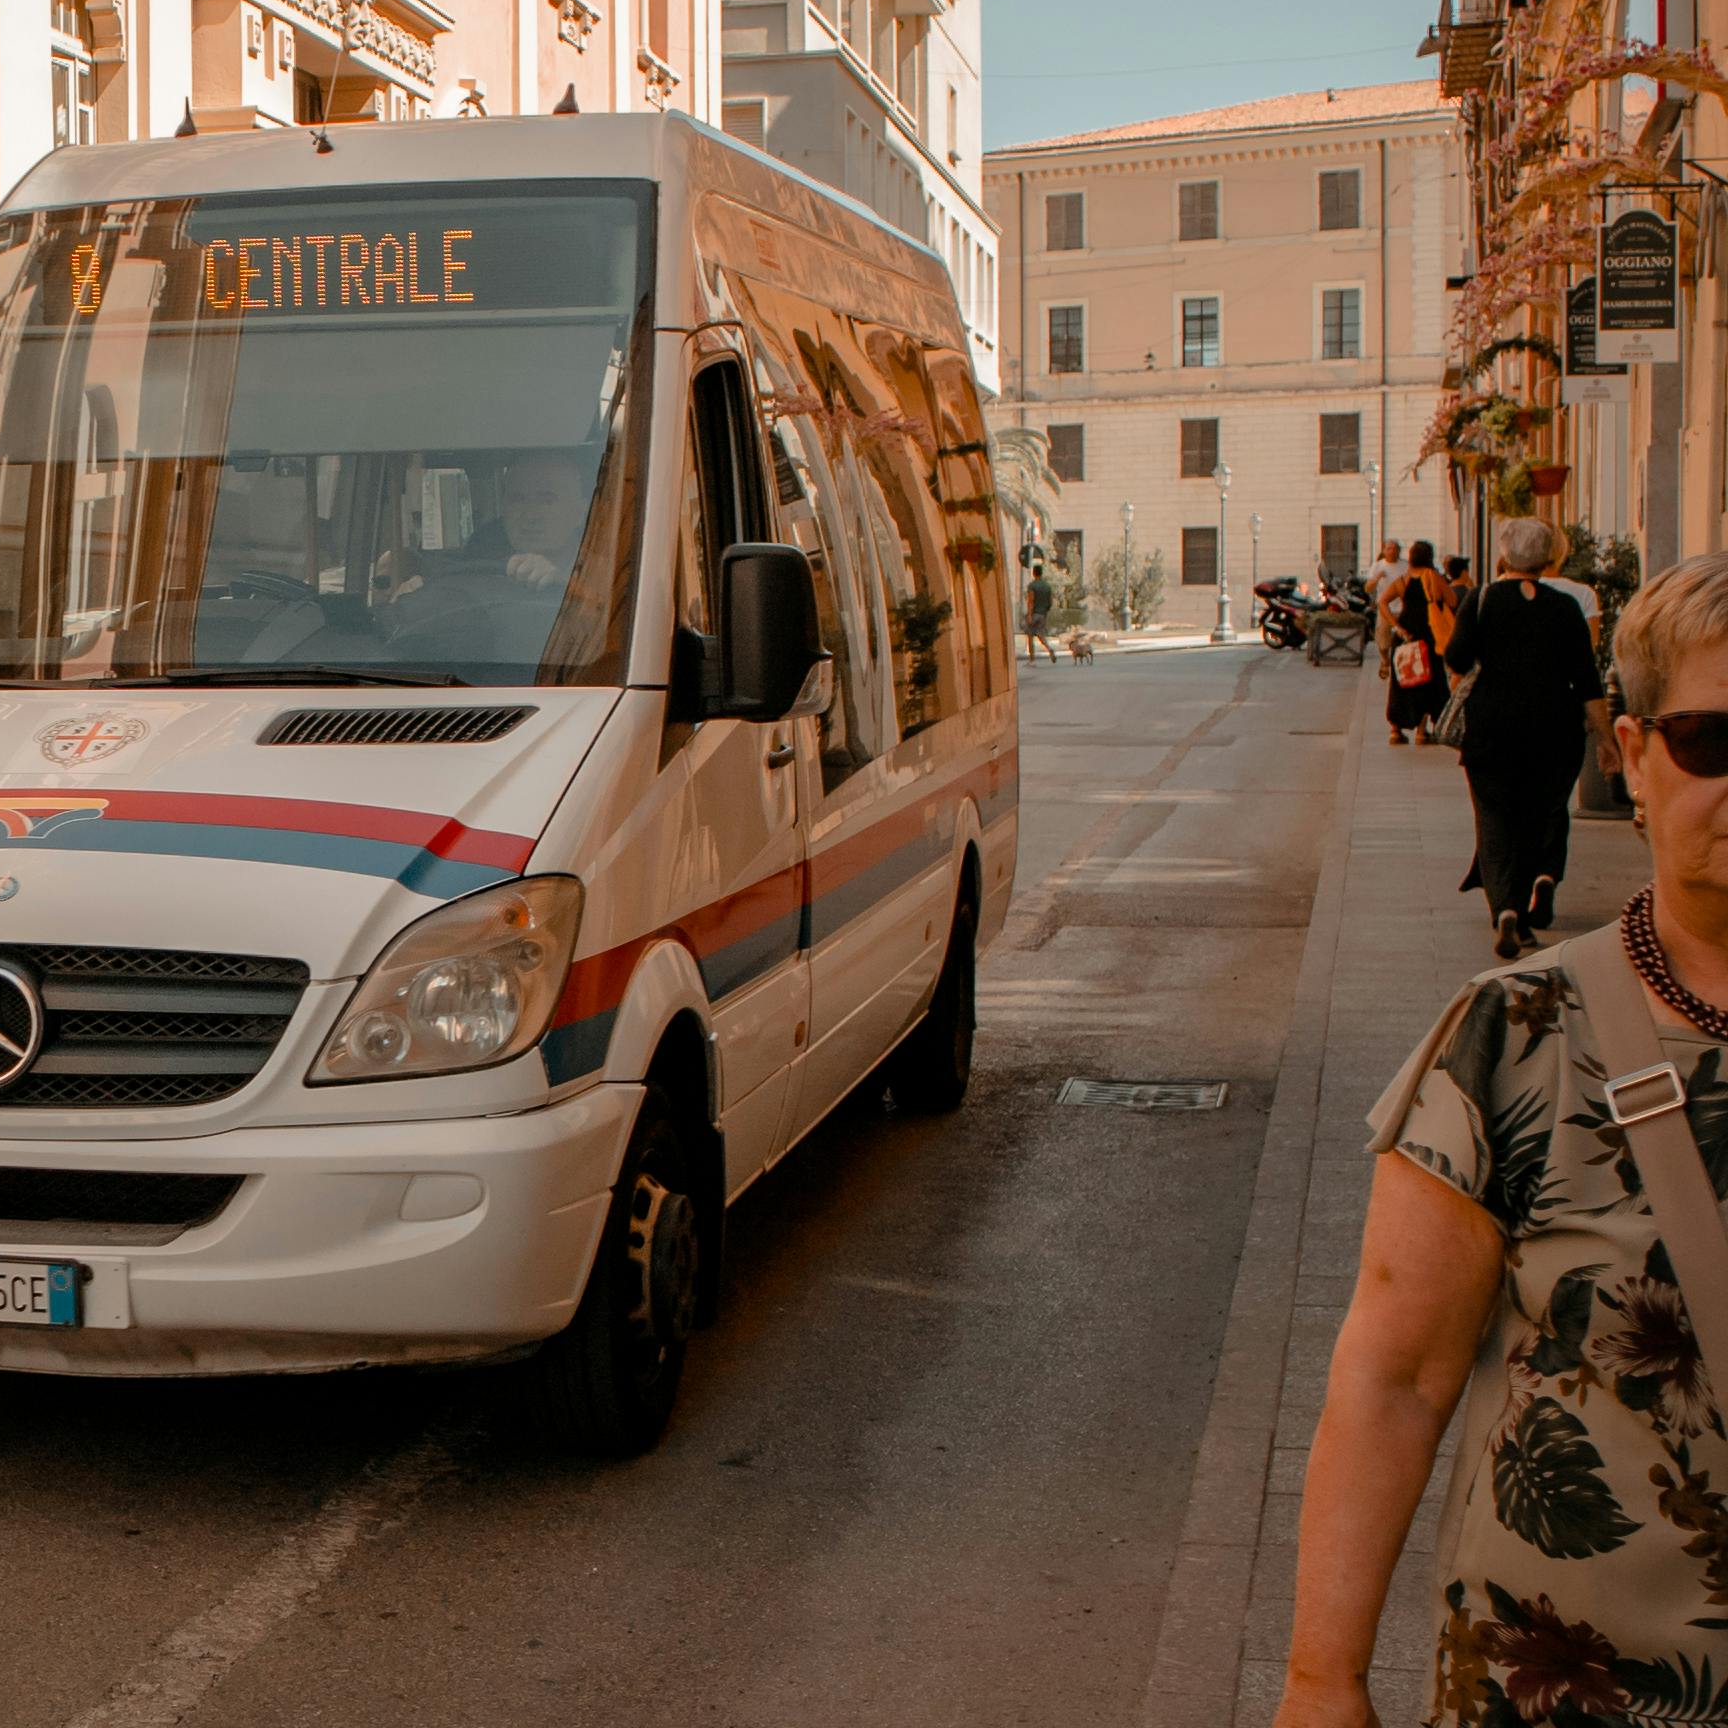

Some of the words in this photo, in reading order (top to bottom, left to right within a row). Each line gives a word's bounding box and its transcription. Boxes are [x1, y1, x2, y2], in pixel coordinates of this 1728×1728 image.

[71, 243, 101, 313] 8
[205, 229, 474, 309] CENTRALE
[1604, 255, 1672, 270] OGGIANO
